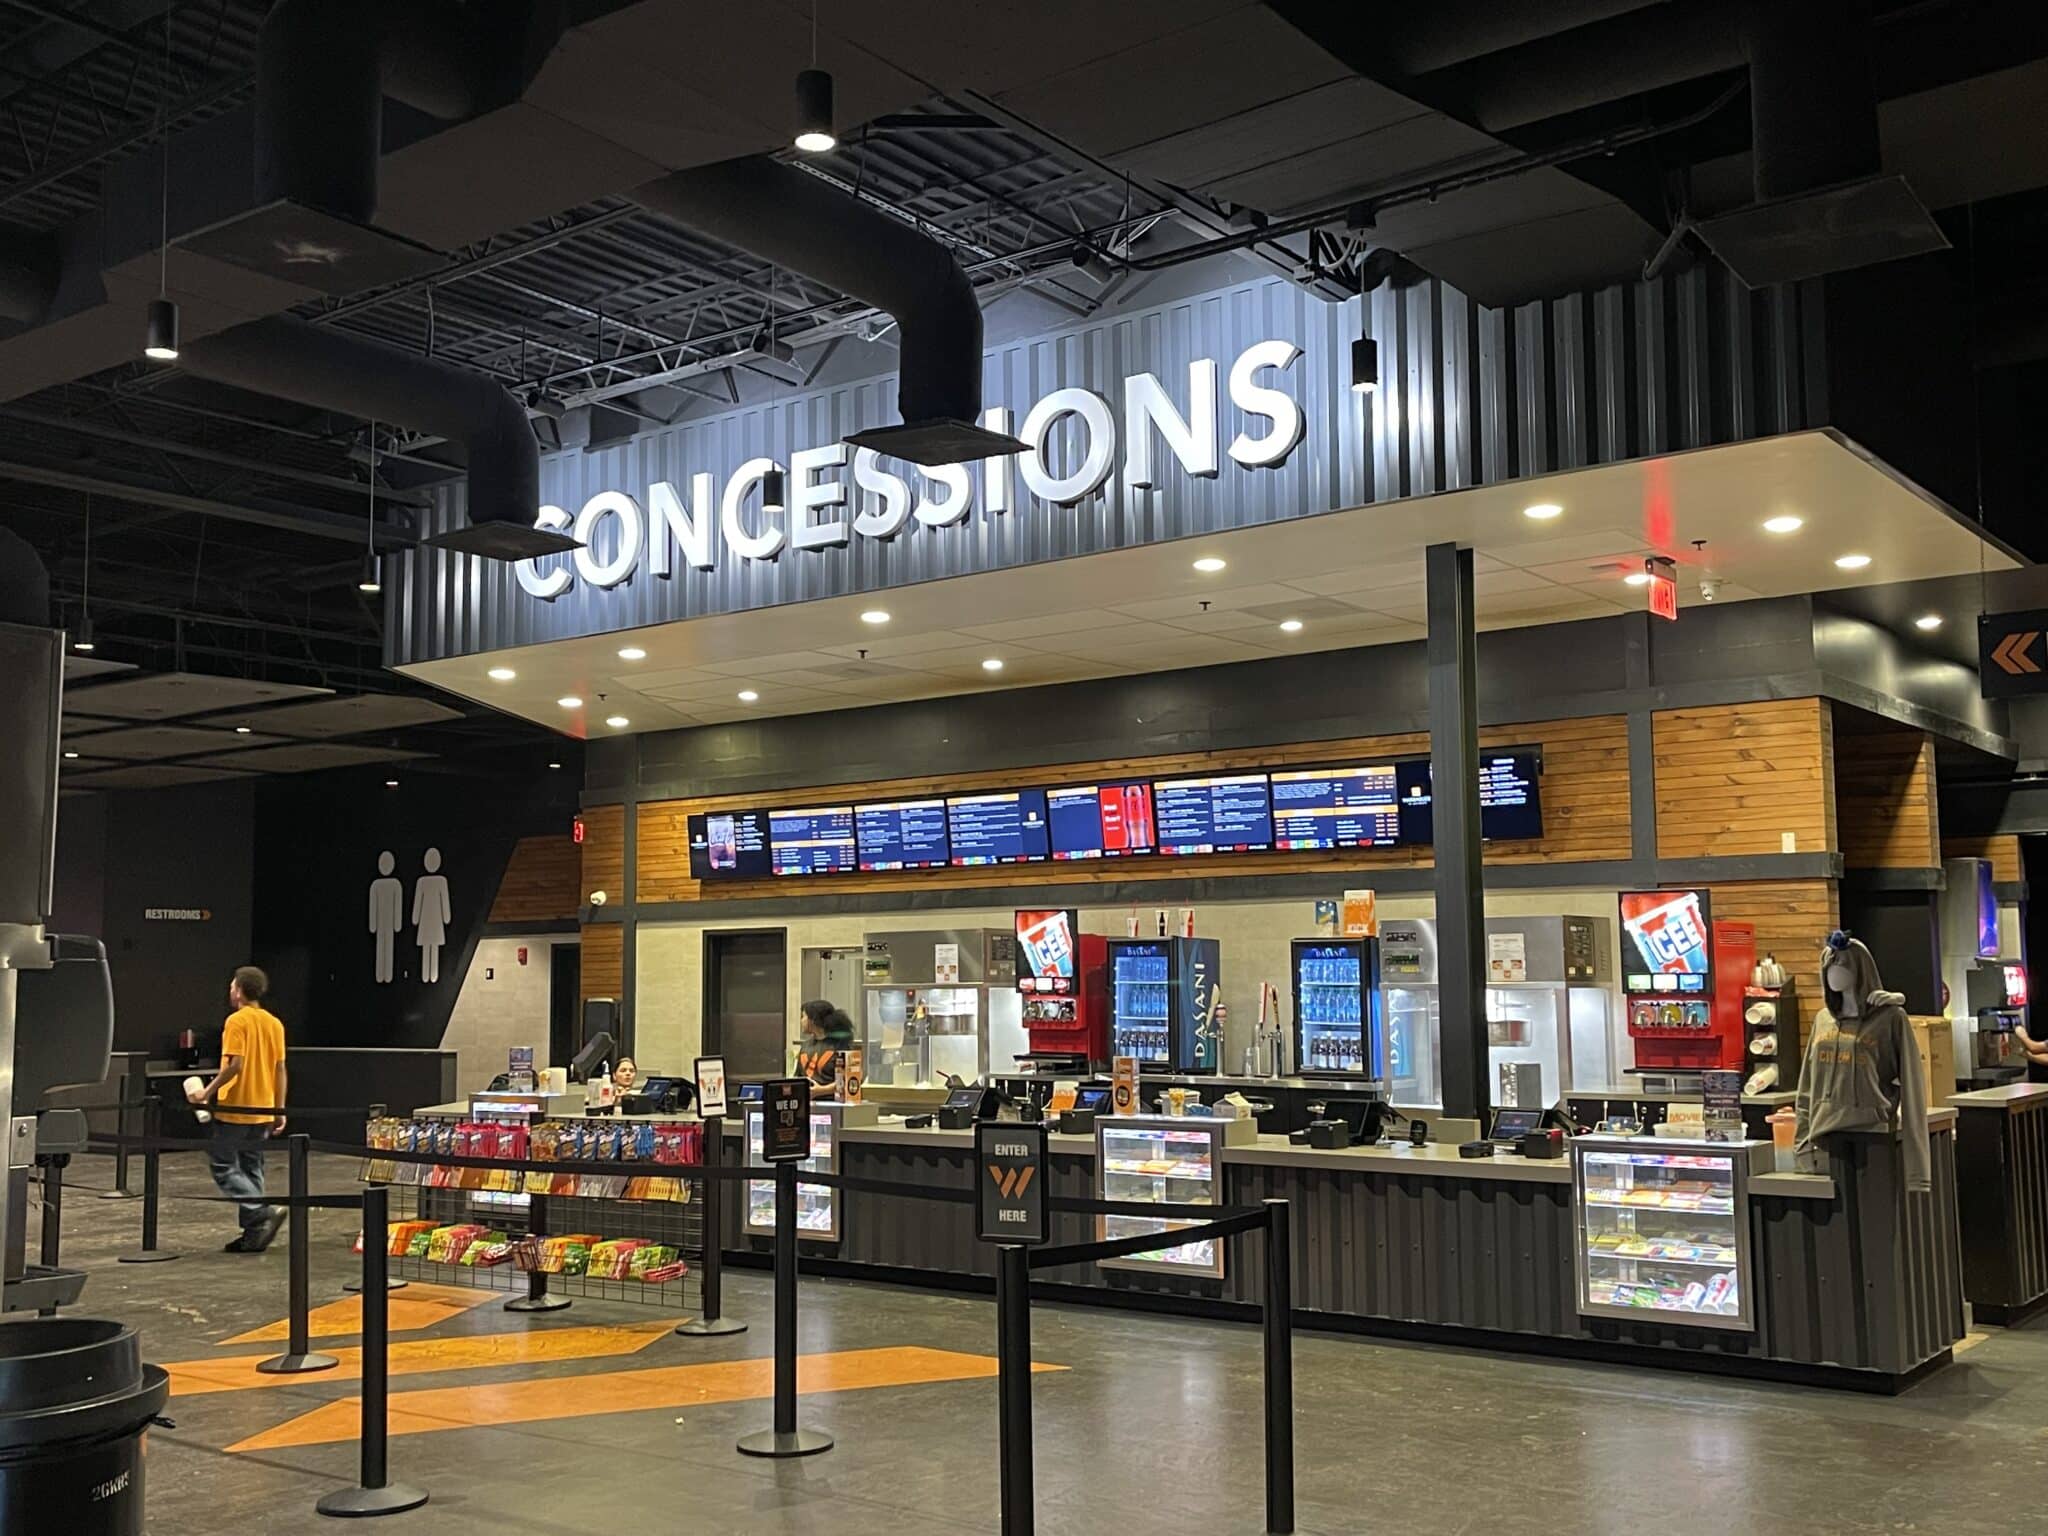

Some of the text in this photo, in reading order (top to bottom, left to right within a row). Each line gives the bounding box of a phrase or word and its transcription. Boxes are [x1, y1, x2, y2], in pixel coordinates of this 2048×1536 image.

[514, 339, 1305, 597] CONCESSIONS
[145, 909, 200, 919] RESTROOMS
[1033, 930, 1071, 969] ICEE
[1643, 915, 1702, 966] ICEE
[1193, 963, 1206, 1057] DASANI
[775, 1100, 798, 1110] WE ID
[994, 1144, 1028, 1156] ENTER
[998, 1209, 1027, 1222] HERE
